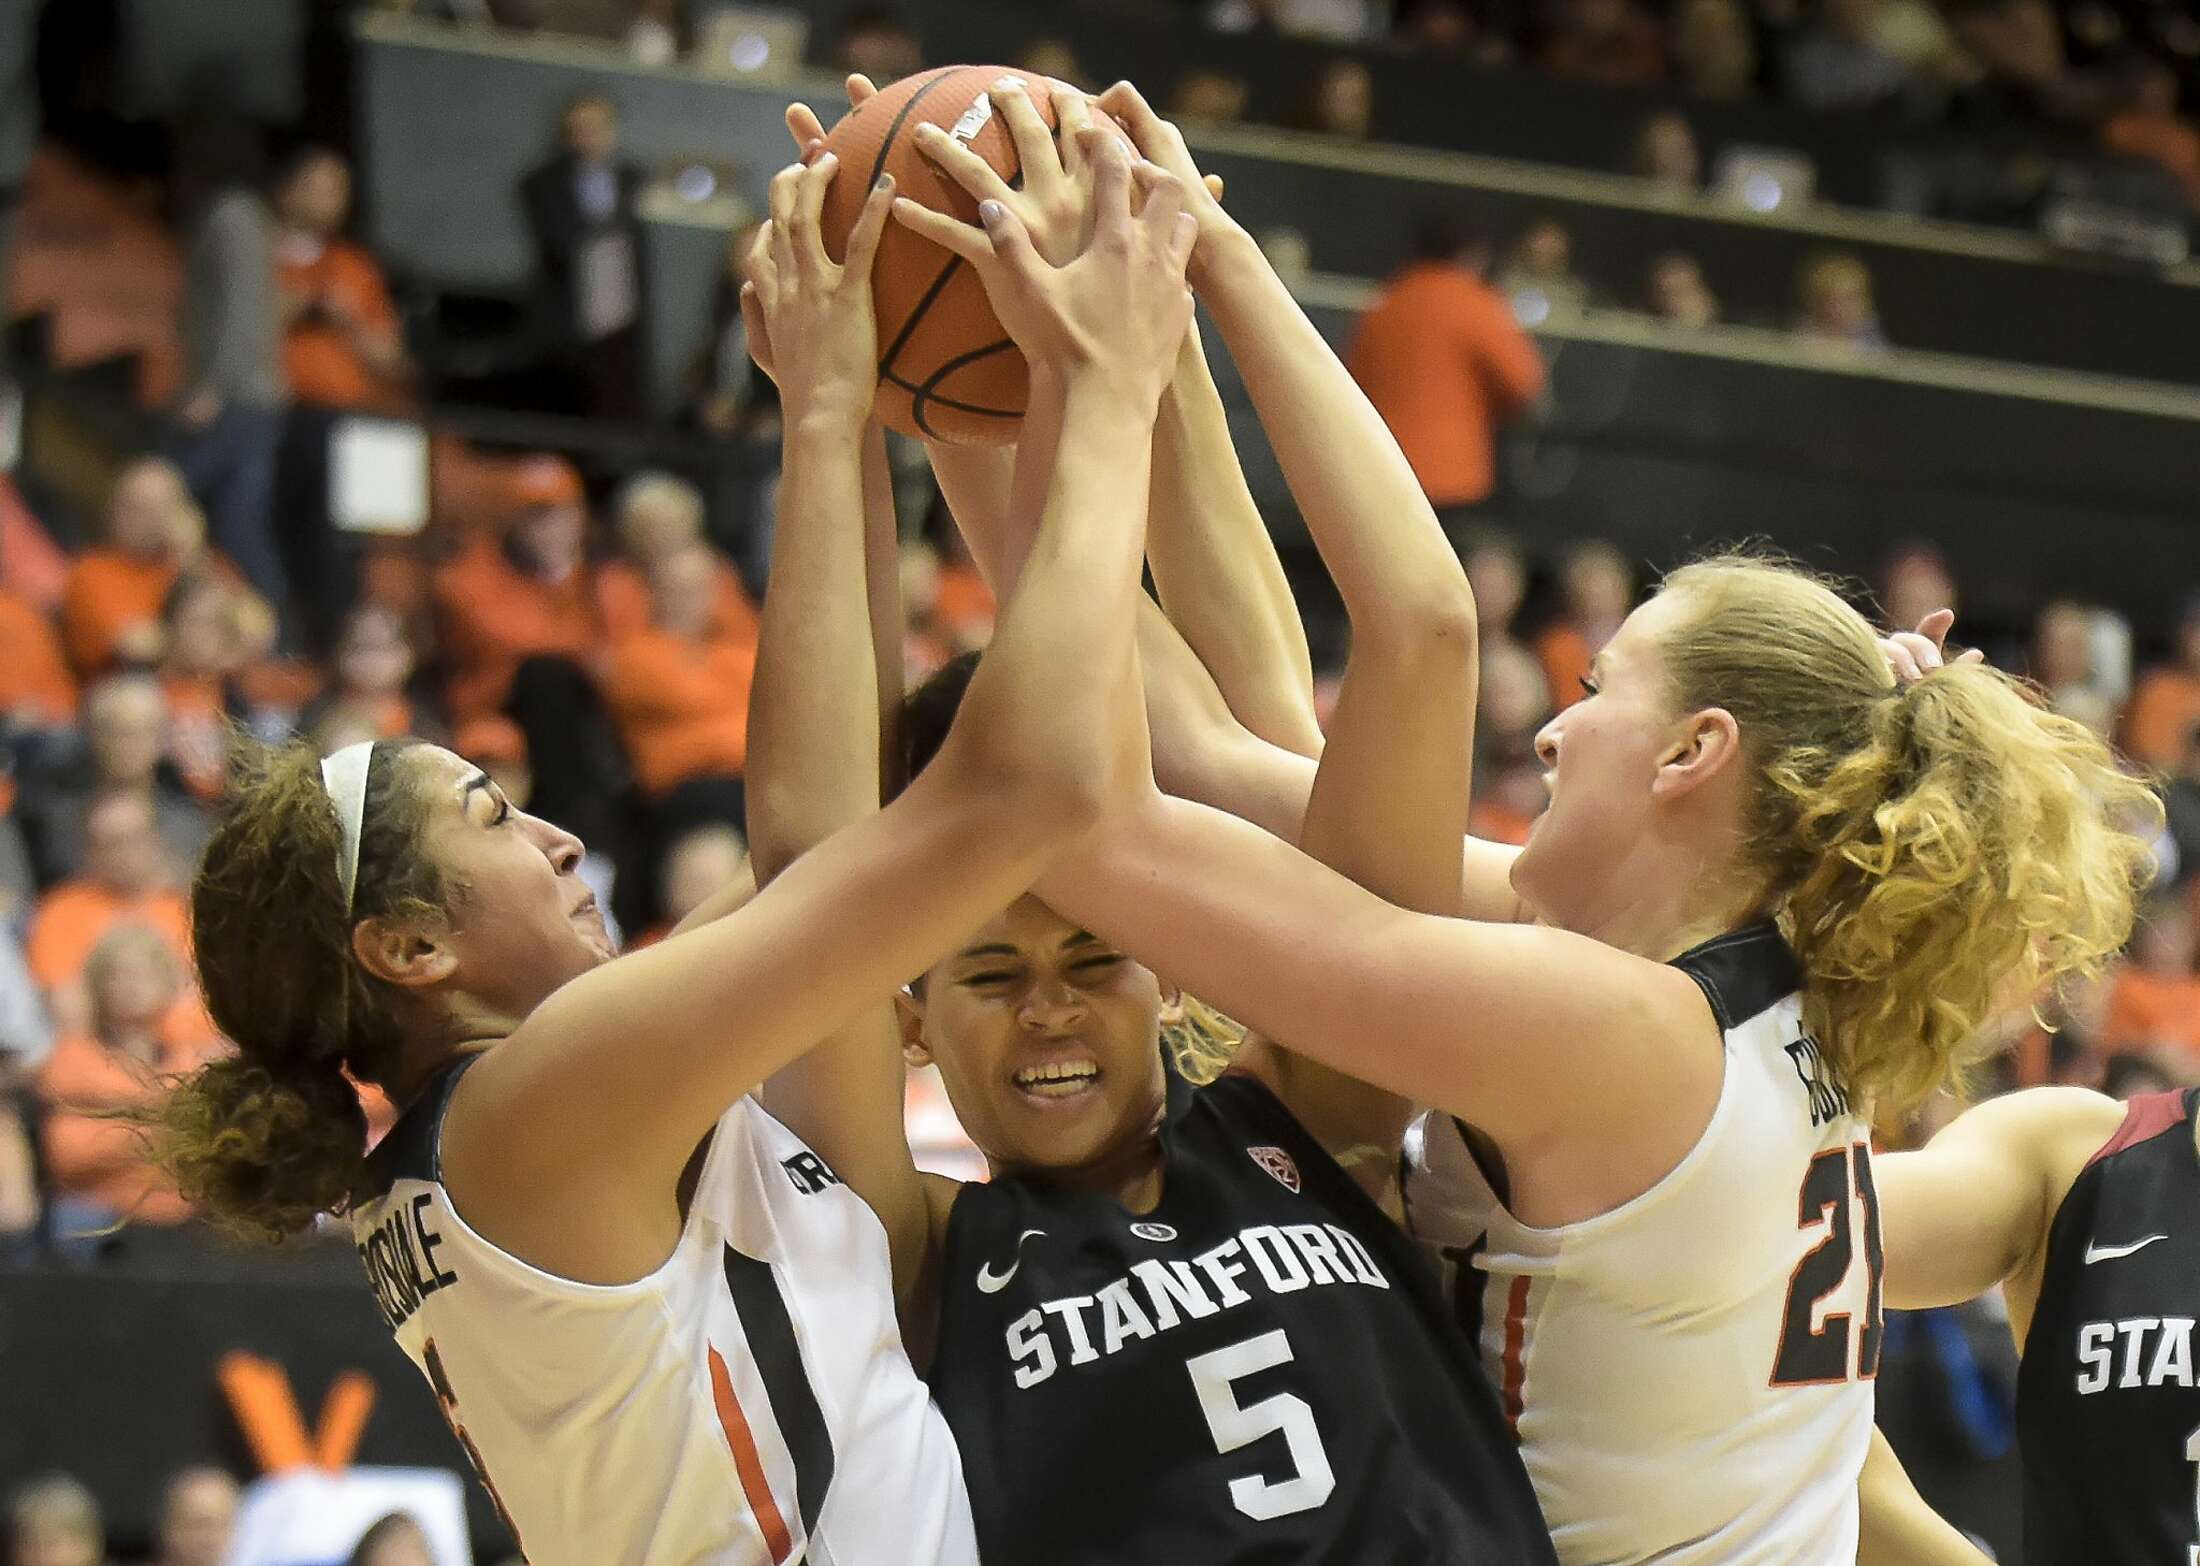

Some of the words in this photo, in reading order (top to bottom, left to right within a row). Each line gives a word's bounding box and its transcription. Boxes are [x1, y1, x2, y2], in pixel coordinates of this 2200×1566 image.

[1005, 1223, 1390, 1389] STANFORD
[1769, 1141, 1884, 1388] 21
[1186, 1328, 1336, 1521] 5
[2078, 1317, 2200, 1395] STA
